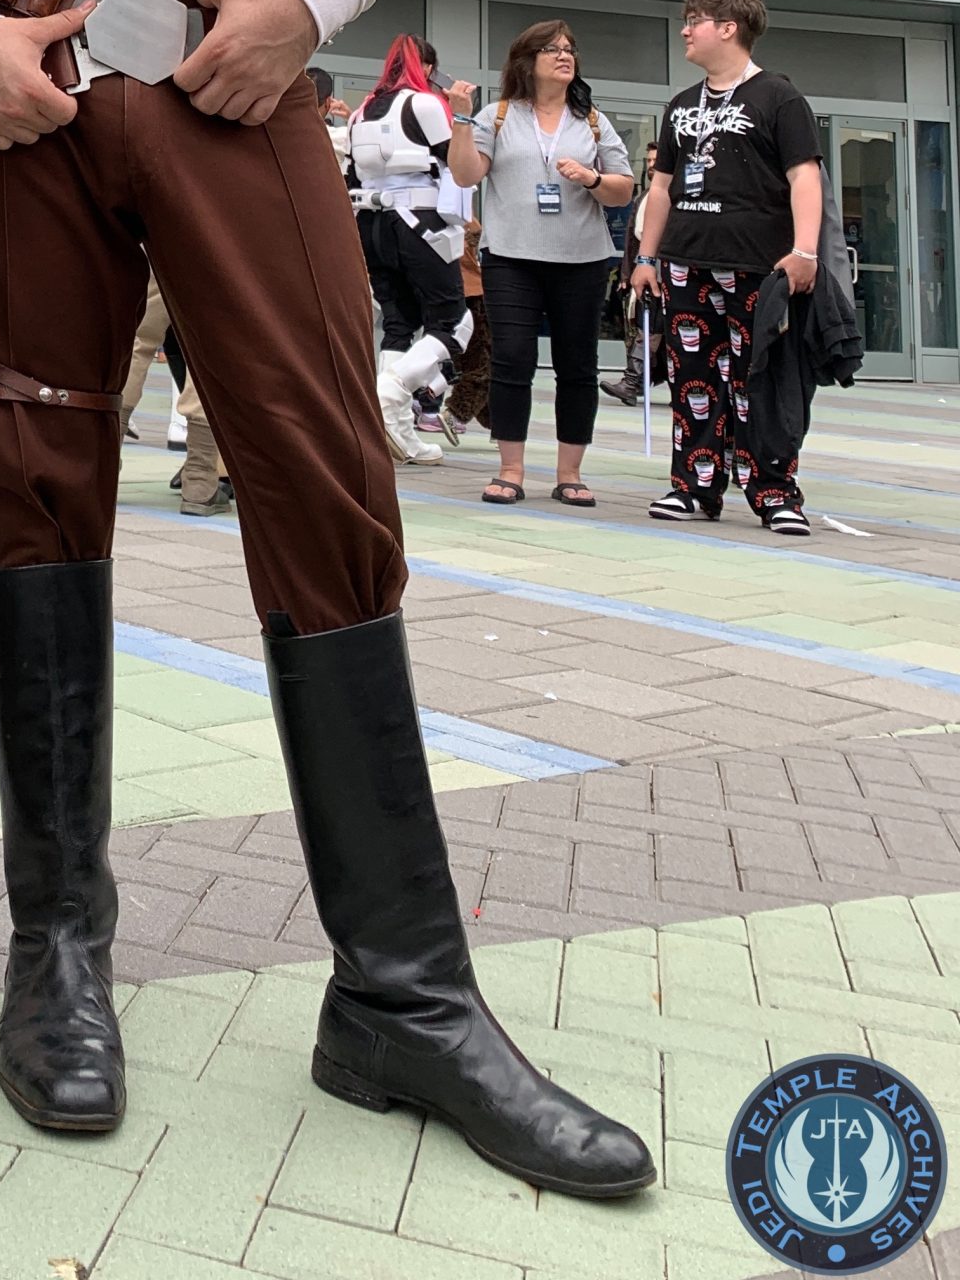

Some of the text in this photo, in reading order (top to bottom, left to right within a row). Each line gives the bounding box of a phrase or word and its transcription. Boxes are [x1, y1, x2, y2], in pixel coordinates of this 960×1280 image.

[708, 342, 729, 368] CAUTIO
[680, 380, 719, 404] CAUTION HOT
[687, 448, 712, 472] CAUTION
